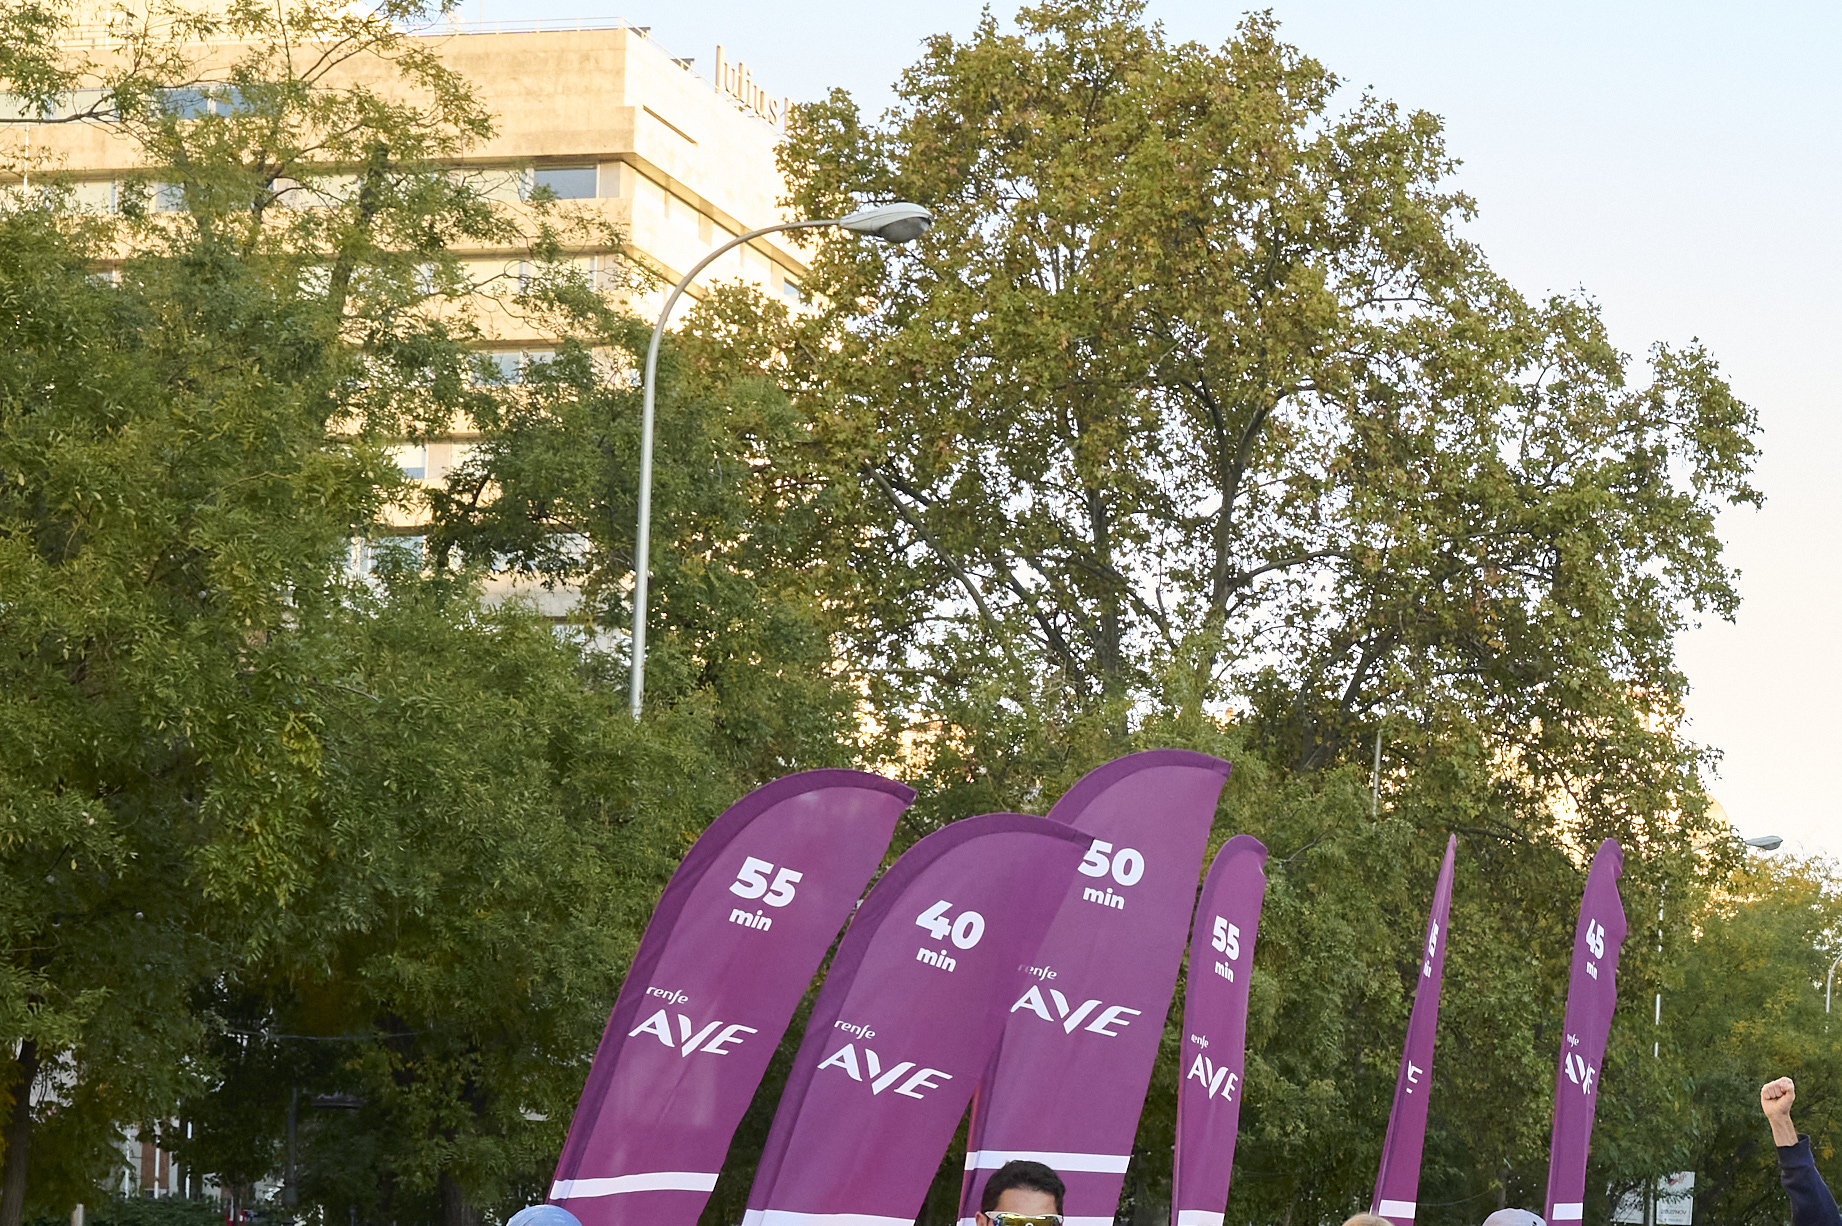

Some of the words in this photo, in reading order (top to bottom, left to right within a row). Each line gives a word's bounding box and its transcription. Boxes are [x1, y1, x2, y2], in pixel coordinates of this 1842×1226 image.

[729, 856, 803, 908] 55
[1077, 839, 1145, 887] 50
[728, 907, 773, 933] min
[1082, 885, 1126, 911] min
[915, 899, 986, 951] 40
[1211, 915, 1240, 962] 55
[1585, 918, 1606, 960] 45
[916, 947, 957, 974] min
[1214, 960, 1235, 984] min
[645, 986, 690, 1006] renfe
[1010, 985, 1143, 1038] AVE
[628, 1009, 759, 1058] AVE
[834, 1019, 877, 1041] renfe
[817, 1043, 954, 1100] AVE
[1186, 1052, 1240, 1103] AVE
